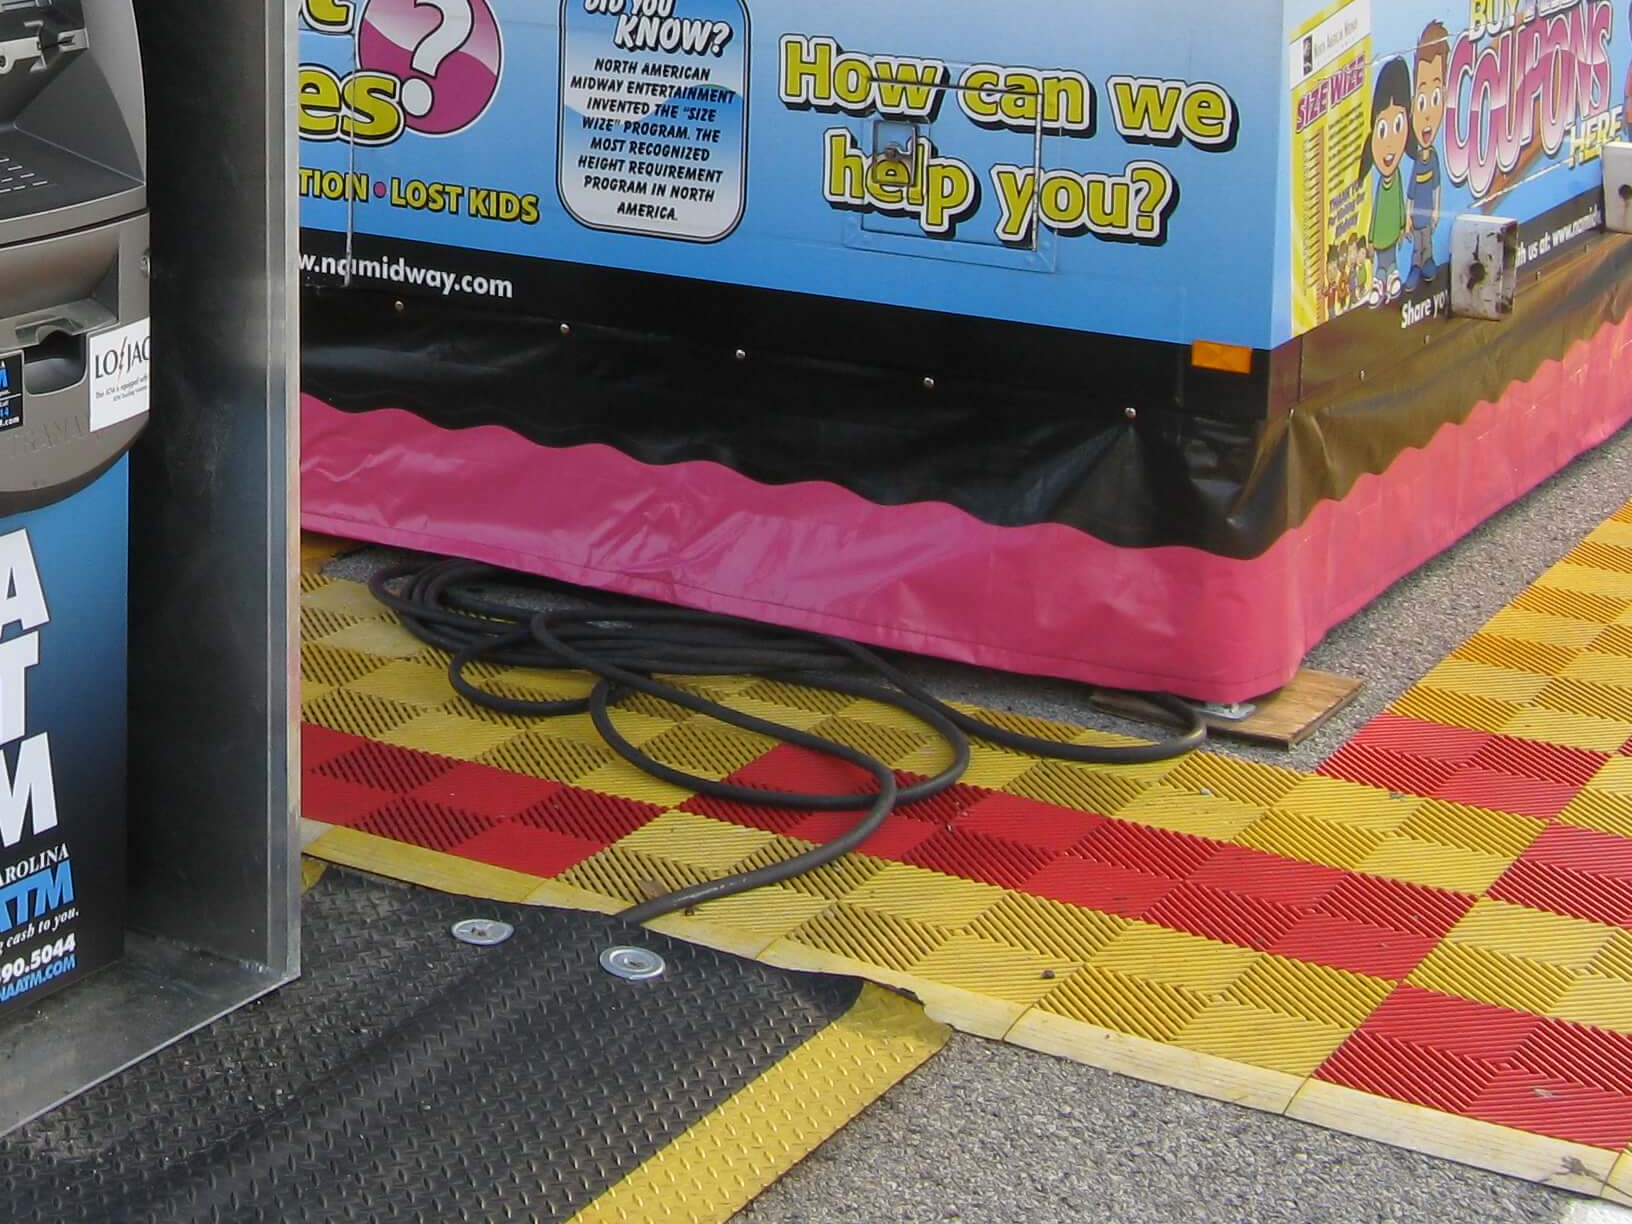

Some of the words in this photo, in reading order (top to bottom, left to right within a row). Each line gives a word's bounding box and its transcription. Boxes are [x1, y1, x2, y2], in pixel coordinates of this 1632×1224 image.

[615, 15, 732, 57] KNOW?
[594, 58, 638, 75] NORTH
[641, 62, 711, 81] AMERICAN
[570, 75, 624, 93] MIDWAY
[627, 81, 737, 104] ENTERTAINMENT
[781, 36, 945, 116] How
[961, 64, 1091, 130] can
[1108, 77, 1233, 144] we
[1445, 0, 1612, 197] COUPONS
[587, 96, 650, 116] INVENTED
[655, 104, 679, 119] THE
[1296, 80, 1328, 133] SIZE
[623, 120, 691, 141] PROGRAM.
[696, 127, 721, 143] THE
[1569, 106, 1622, 167] HERE
[590, 137, 626, 153] MOST
[629, 141, 711, 162] RECOGNIZED
[578, 154, 626, 172] HEIGHT
[629, 161, 724, 184] REQUIREMENT
[825, 129, 974, 233] help
[992, 161, 1174, 239] you?
[390, 177, 464, 215] LOST
[469, 187, 540, 223] KIDS
[584, 175, 648, 195] PROGRAM
[651, 183, 667, 197] IN
[670, 186, 716, 203] NORTH
[617, 201, 679, 222] AMERICA.
[1401, 298, 1432, 328] Share
[6, 923, 36, 949] cash
[38, 918, 52, 934] to
[52, 907, 79, 932] you.
